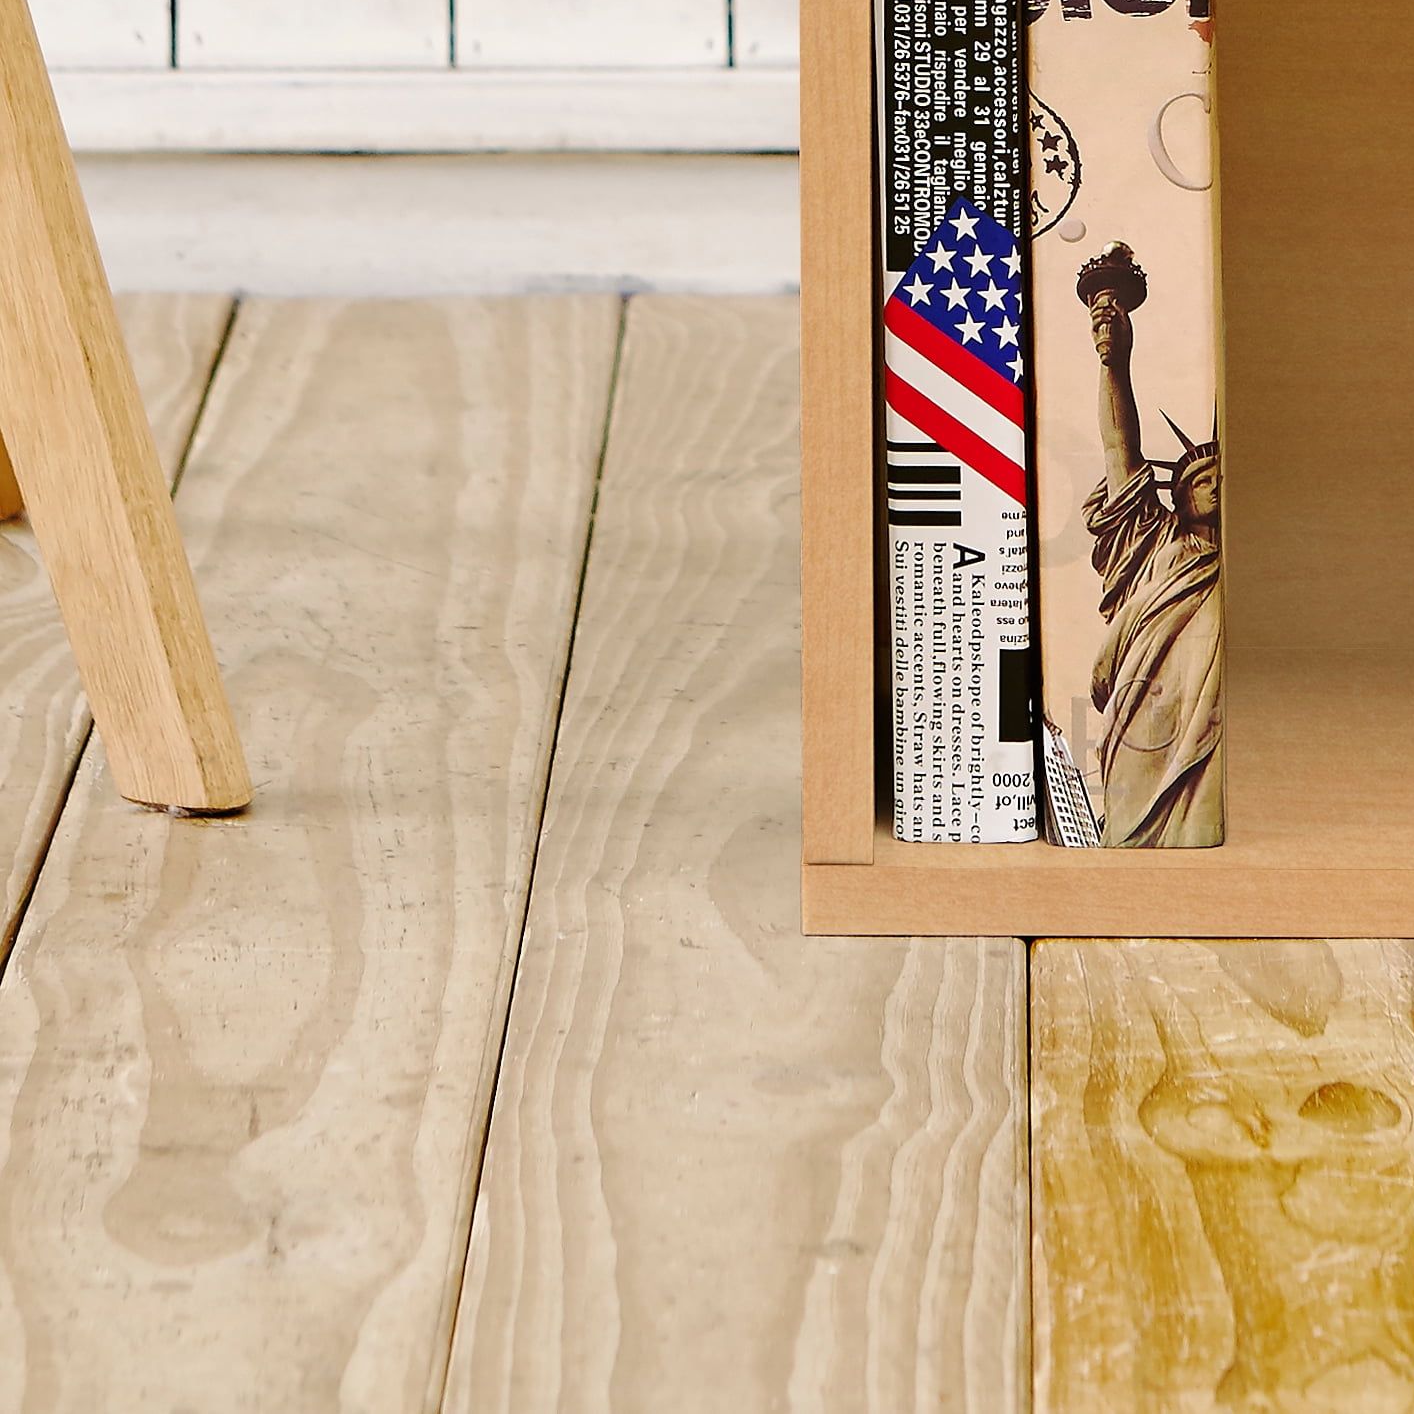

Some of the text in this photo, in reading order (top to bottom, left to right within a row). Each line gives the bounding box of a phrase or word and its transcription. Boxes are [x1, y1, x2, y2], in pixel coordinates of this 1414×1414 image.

[950, 5, 967, 35] per
[973, 40, 991, 62] 29
[914, 41, 931, 107] STUDIO
[930, 49, 951, 122] rispedire
[954, 48, 971, 118] vendere
[973, 76, 992, 92] al
[973, 106, 991, 126] 31
[933, 135, 951, 146] il
[950, 132, 970, 192] meglio
[894, 193, 910, 211] 51
[894, 215, 910, 235] 25
[895, 539, 910, 570] Sui
[952, 542, 986, 570] A
[913, 542, 928, 627] romantic
[932, 542, 947, 616] beneath
[952, 573, 966, 607] and
[895, 575, 908, 632] vestiti
[895, 637, 909, 682] delle
[952, 612, 966, 671] hearts
[968, 574, 986, 707] Kaleodpskope
[912, 632, 926, 707] accents,
[951, 676, 963, 699] on
[895, 687, 909, 766] bambine
[912, 711, 928, 768] Straw
[951, 703, 966, 777] dresses.
[971, 711, 985, 731] of
[895, 771, 905, 793] un
[932, 735, 946, 789] skirts
[992, 772, 1031, 788] 2000
[912, 772, 927, 812] hats
[932, 794, 946, 828] and
[951, 782, 966, 827] Lace
